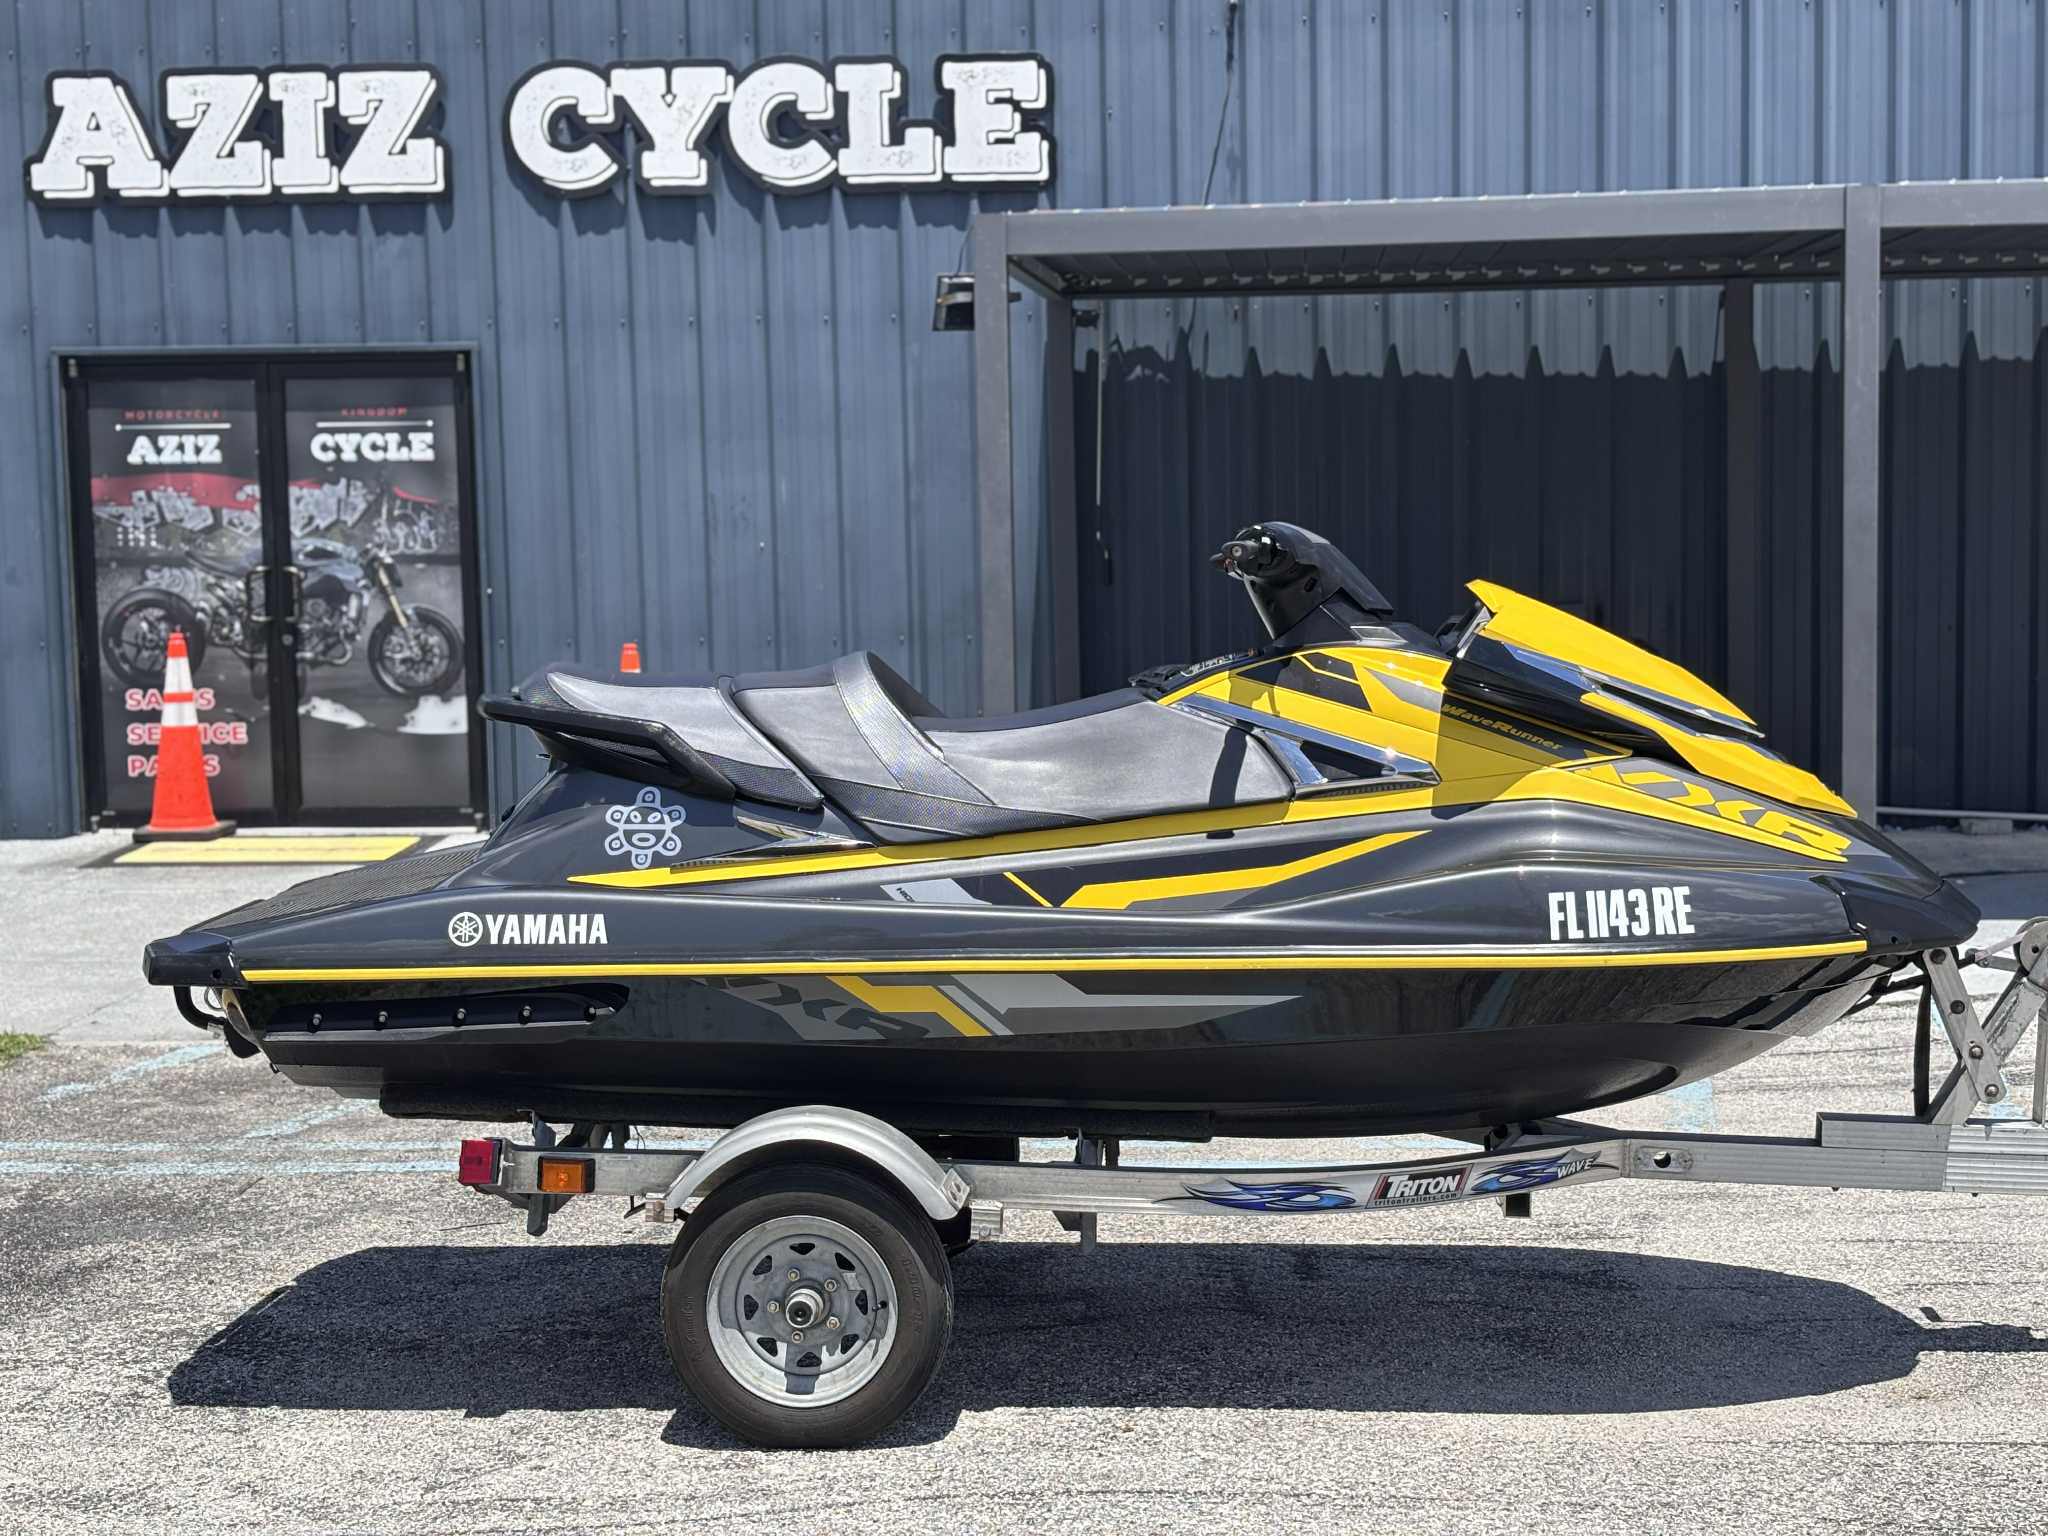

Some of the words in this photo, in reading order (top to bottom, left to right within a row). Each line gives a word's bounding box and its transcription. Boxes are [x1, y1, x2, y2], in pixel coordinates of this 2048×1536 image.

[30, 70, 446, 199] AZIZ
[509, 59, 1050, 191] CYCLE
[126, 434, 223, 465] AZIZ
[310, 431, 435, 463] CYCLE
[125, 687, 217, 711] SAS
[127, 722, 249, 746] SEICE
[1441, 703, 1564, 750] WaveRunner
[127, 753, 222, 778] PAS
[485, 913, 609, 945] YAMAHA
[1557, 1158, 1596, 1179] WAVE
[1386, 1174, 1462, 1198] TRITON
